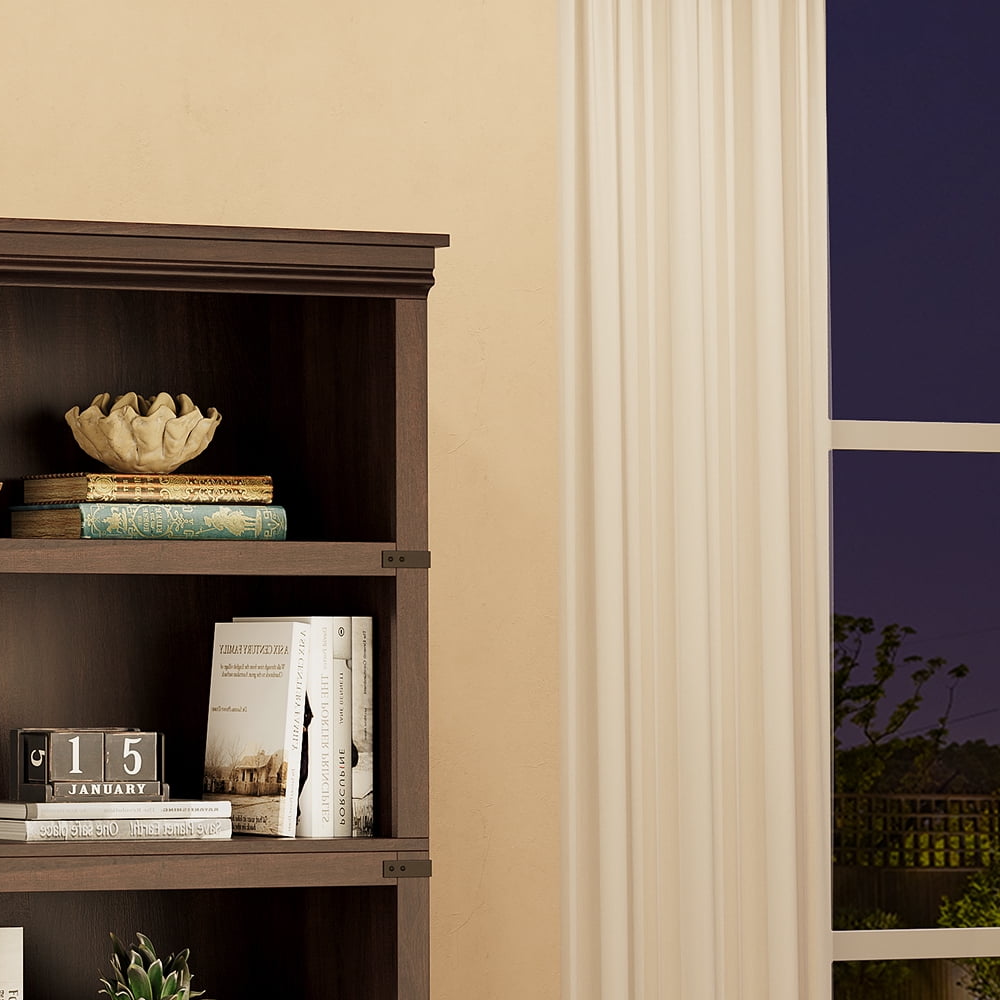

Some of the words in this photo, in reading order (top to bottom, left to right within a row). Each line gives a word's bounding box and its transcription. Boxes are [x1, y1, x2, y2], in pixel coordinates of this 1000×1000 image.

[68, 736, 83, 774] 1
[123, 737, 142, 775] 5
[68, 784, 146, 795] JANUARY
